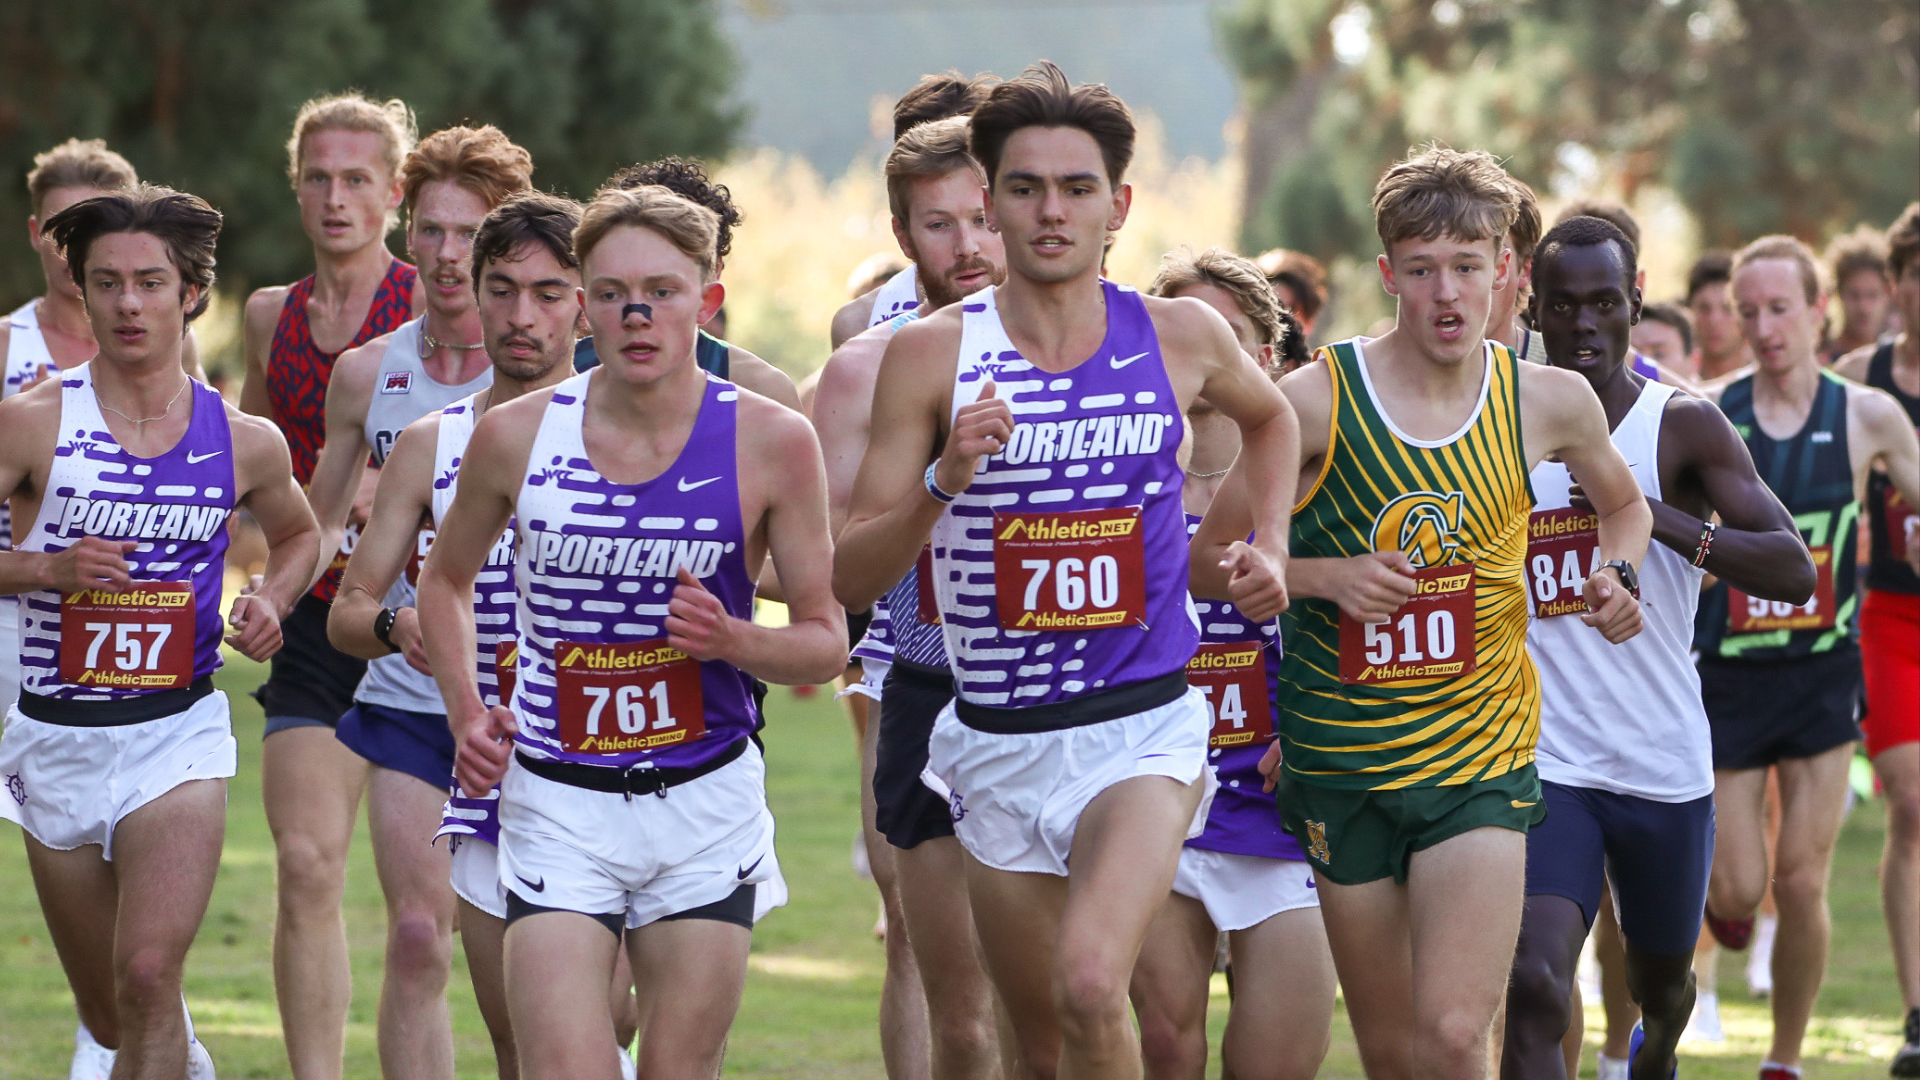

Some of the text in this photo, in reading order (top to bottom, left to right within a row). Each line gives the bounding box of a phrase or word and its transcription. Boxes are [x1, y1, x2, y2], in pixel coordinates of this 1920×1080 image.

[974, 412, 1165, 474] ORTLAND
[57, 495, 226, 542] PORTLAND
[534, 529, 725, 579] PORTLAND
[1021, 554, 1119, 611] 760
[84, 622, 173, 671] 757
[1364, 609, 1456, 665] 510
[582, 680, 677, 736] 761
